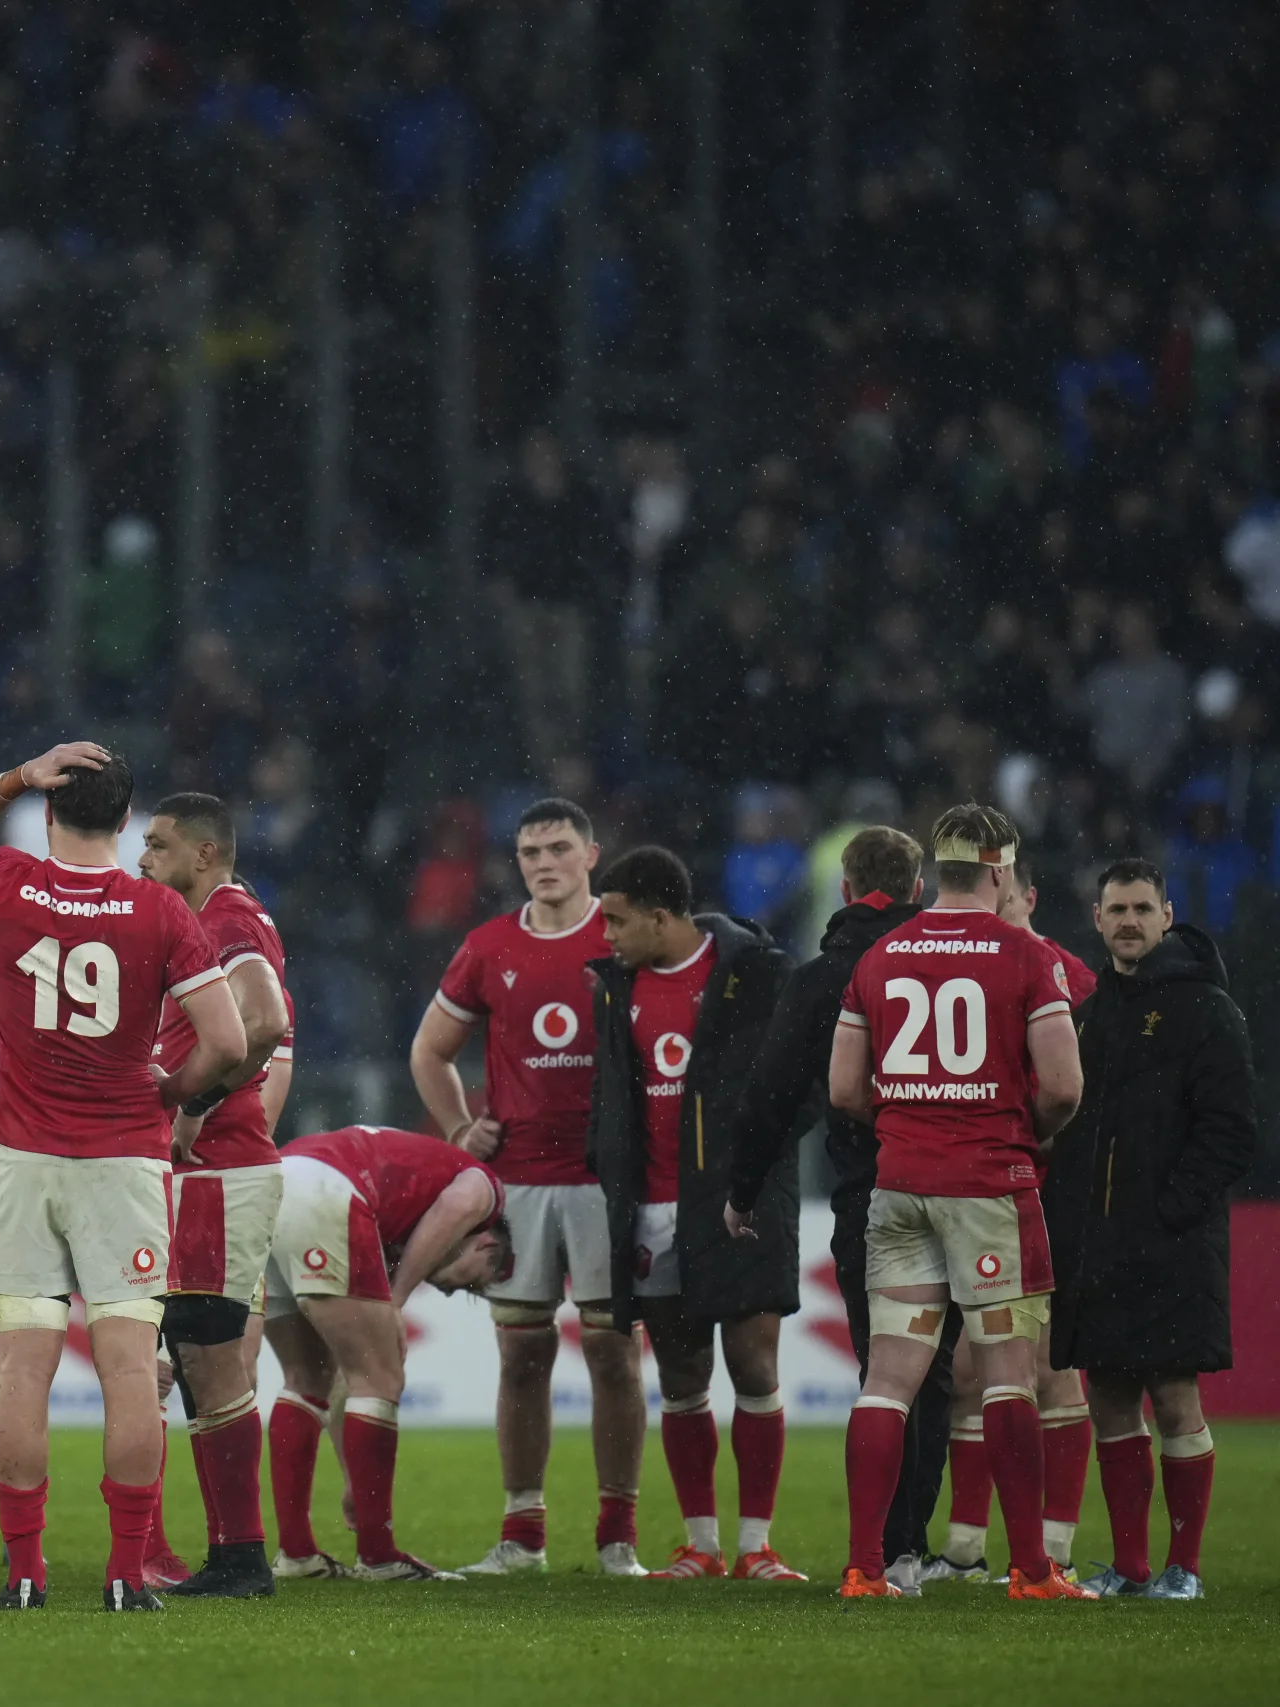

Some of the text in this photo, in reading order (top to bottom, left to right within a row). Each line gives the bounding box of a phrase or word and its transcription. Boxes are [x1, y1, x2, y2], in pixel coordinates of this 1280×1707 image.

[886, 940, 1000, 954] GO.COMPARE
[15, 936, 120, 1038] 19
[882, 977, 987, 1076] 20
[877, 1083, 999, 1100] WAINWRIGHT
[972, 1279, 1011, 1290] vodafone
